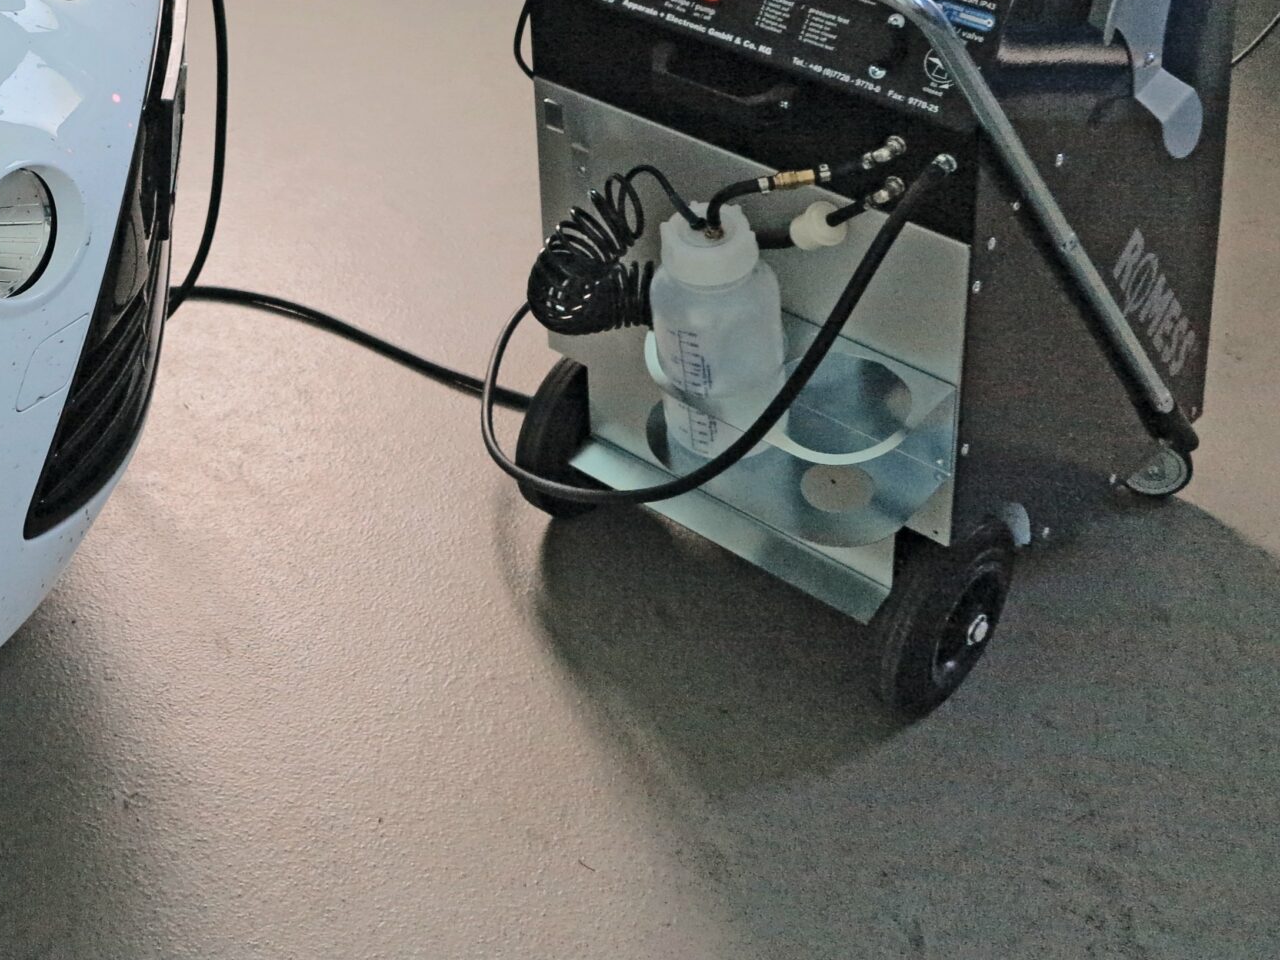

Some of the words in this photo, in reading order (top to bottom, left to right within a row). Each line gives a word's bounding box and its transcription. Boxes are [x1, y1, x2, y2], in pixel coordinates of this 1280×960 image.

[665, 13, 707, 32] Electronic
[707, 27, 733, 42] GmbH
[743, 40, 757, 50] Co.
[961, 30, 985, 43] valve
[1113, 227, 1196, 377] ROMESS
